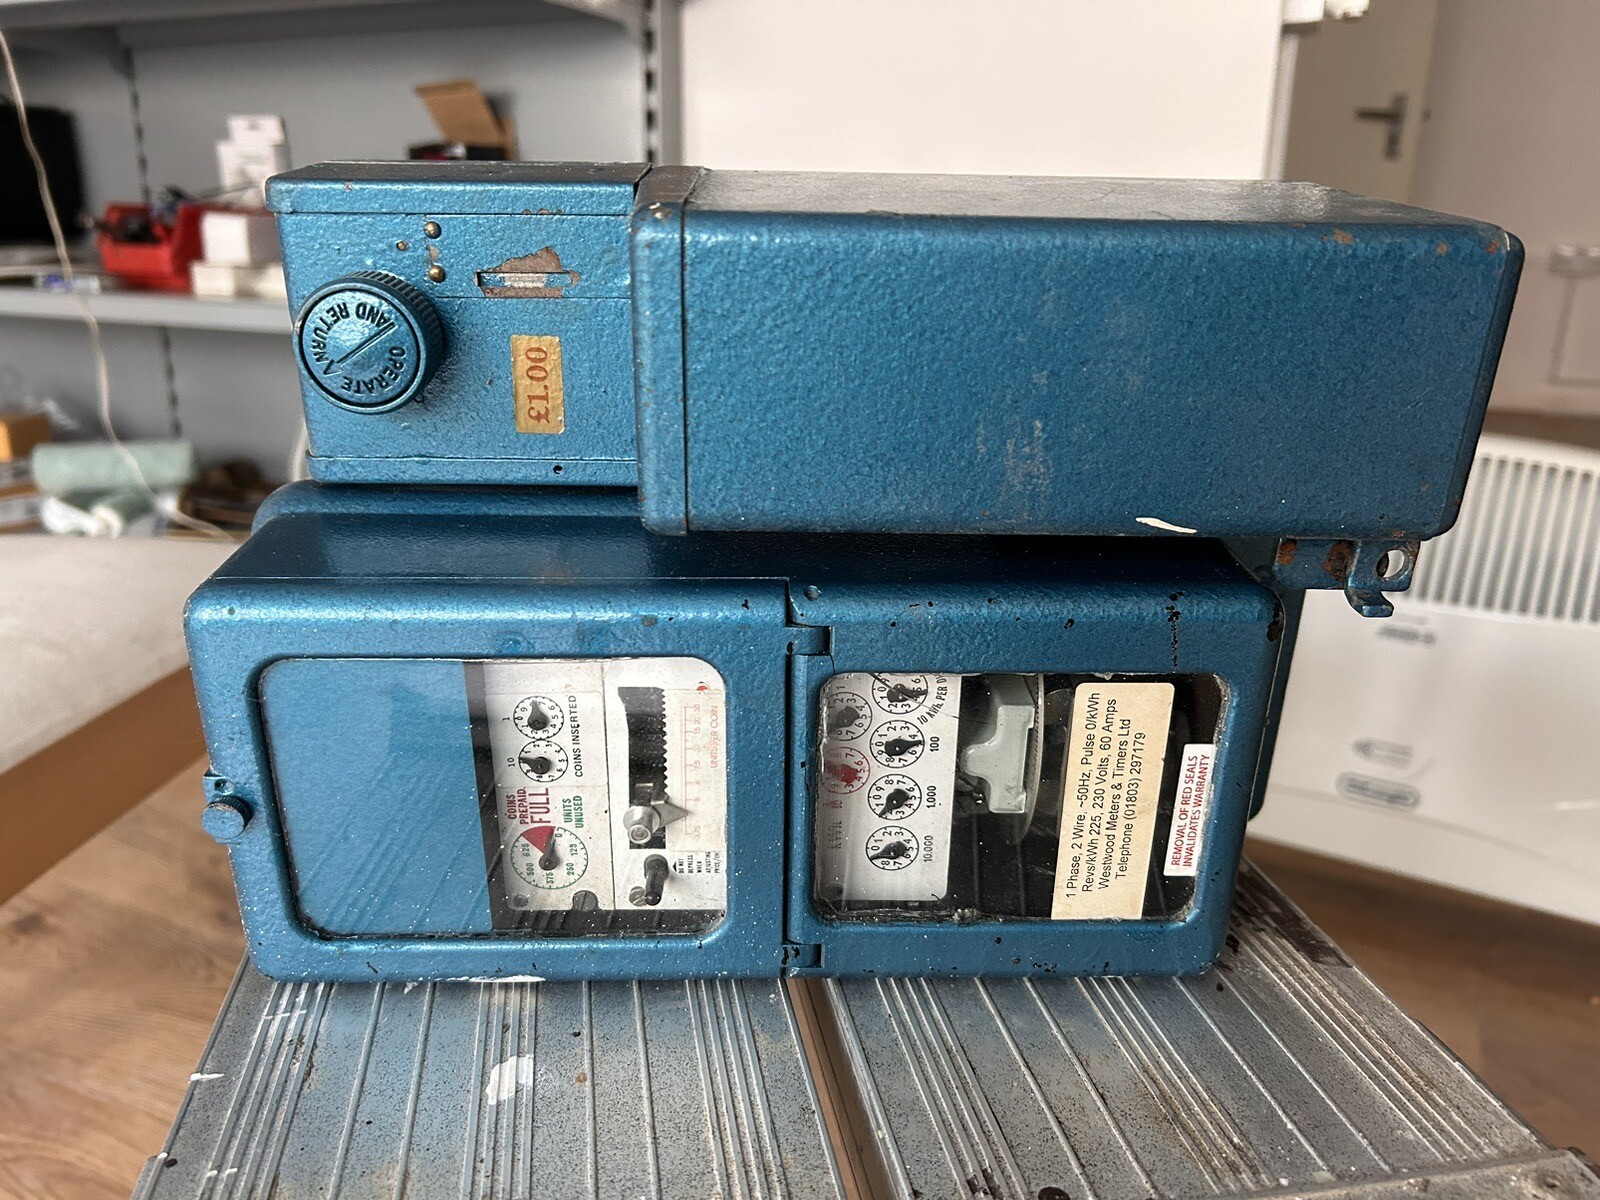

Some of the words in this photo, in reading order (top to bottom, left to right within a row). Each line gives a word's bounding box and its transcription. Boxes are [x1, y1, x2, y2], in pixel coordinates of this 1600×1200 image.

[354, 302, 391, 328] AND
[312, 302, 350, 363] RETURN
[341, 346, 406, 394] OPERATE
[525, 347, 550, 424] £1.00
[568, 695, 581, 745] INSERTED
[917, 715, 928, 725] 10
[936, 686, 948, 701] PER
[1085, 692, 1100, 730] 0/kWh
[1102, 699, 1119, 733] Amps
[1100, 736, 1111, 750] 60
[1118, 718, 1131, 737] Ltd
[930, 736, 940, 752] 100
[1081, 733, 1095, 765] Pulse
[1130, 732, 1146, 775] 297179
[507, 757, 516, 767] 10
[572, 748, 583, 777] COINS
[1095, 754, 1111, 786] Volts,
[1112, 741, 1128, 779] Timers
[1185, 755, 1198, 784] SEALS
[926, 785, 937, 809] 1.000
[1092, 788, 1105, 809] 230
[1111, 782, 1122, 791] &
[1123, 777, 1142, 820] (01803)
[1181, 787, 1193, 806] RED
[506, 794, 517, 819] COINS
[528, 788, 551, 824] FULL
[562, 798, 573, 823] UNITS
[573, 795, 584, 828] UNUSED
[1105, 795, 1121, 831] Meters
[1178, 809, 1189, 820] OF
[1183, 809, 1202, 867] INVALIDATES
[1193, 754, 1210, 808] WARRANTY
[1072, 811, 1088, 841] Wire,
[1089, 811, 1104, 836] 225,
[521, 843, 530, 857] 625
[1071, 842, 1082, 850] 2
[1115, 823, 1134, 879] Telephone
[1171, 821, 1187, 866] REMOVAL
[526, 862, 535, 876] 500
[566, 862, 575, 876] 250
[1066, 852, 1083, 889] Phase,
[1082, 837, 1099, 892] Revs/kWh
[1098, 834, 1116, 889] Westwood
[546, 872, 554, 884] 375
